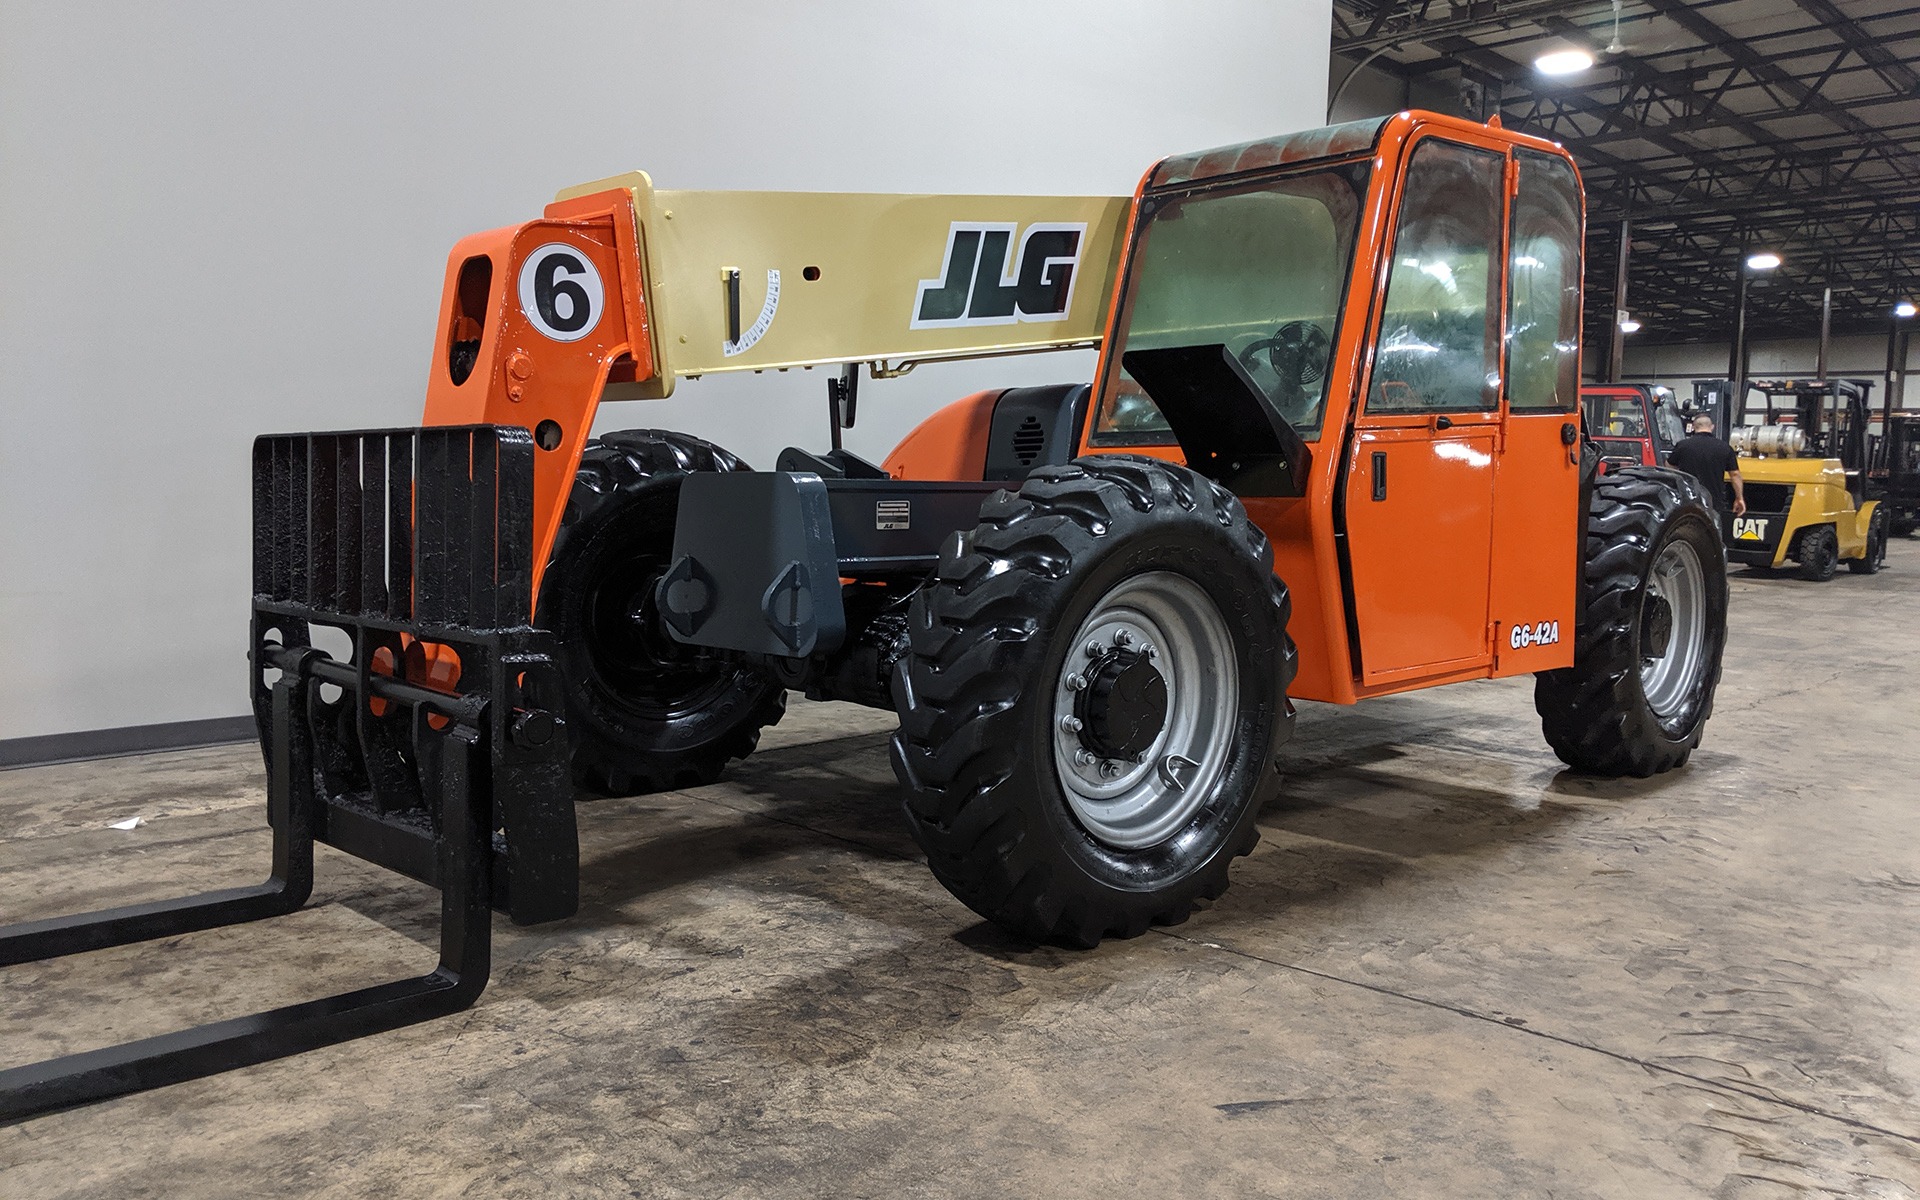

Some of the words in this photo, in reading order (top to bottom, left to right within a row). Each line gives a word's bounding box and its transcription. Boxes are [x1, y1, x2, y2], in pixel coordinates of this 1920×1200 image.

[533, 252, 591, 332] 6
[913, 226, 1085, 325] JLG
[1732, 517, 1769, 541] CAT
[1510, 620, 1559, 650] G6-42A
